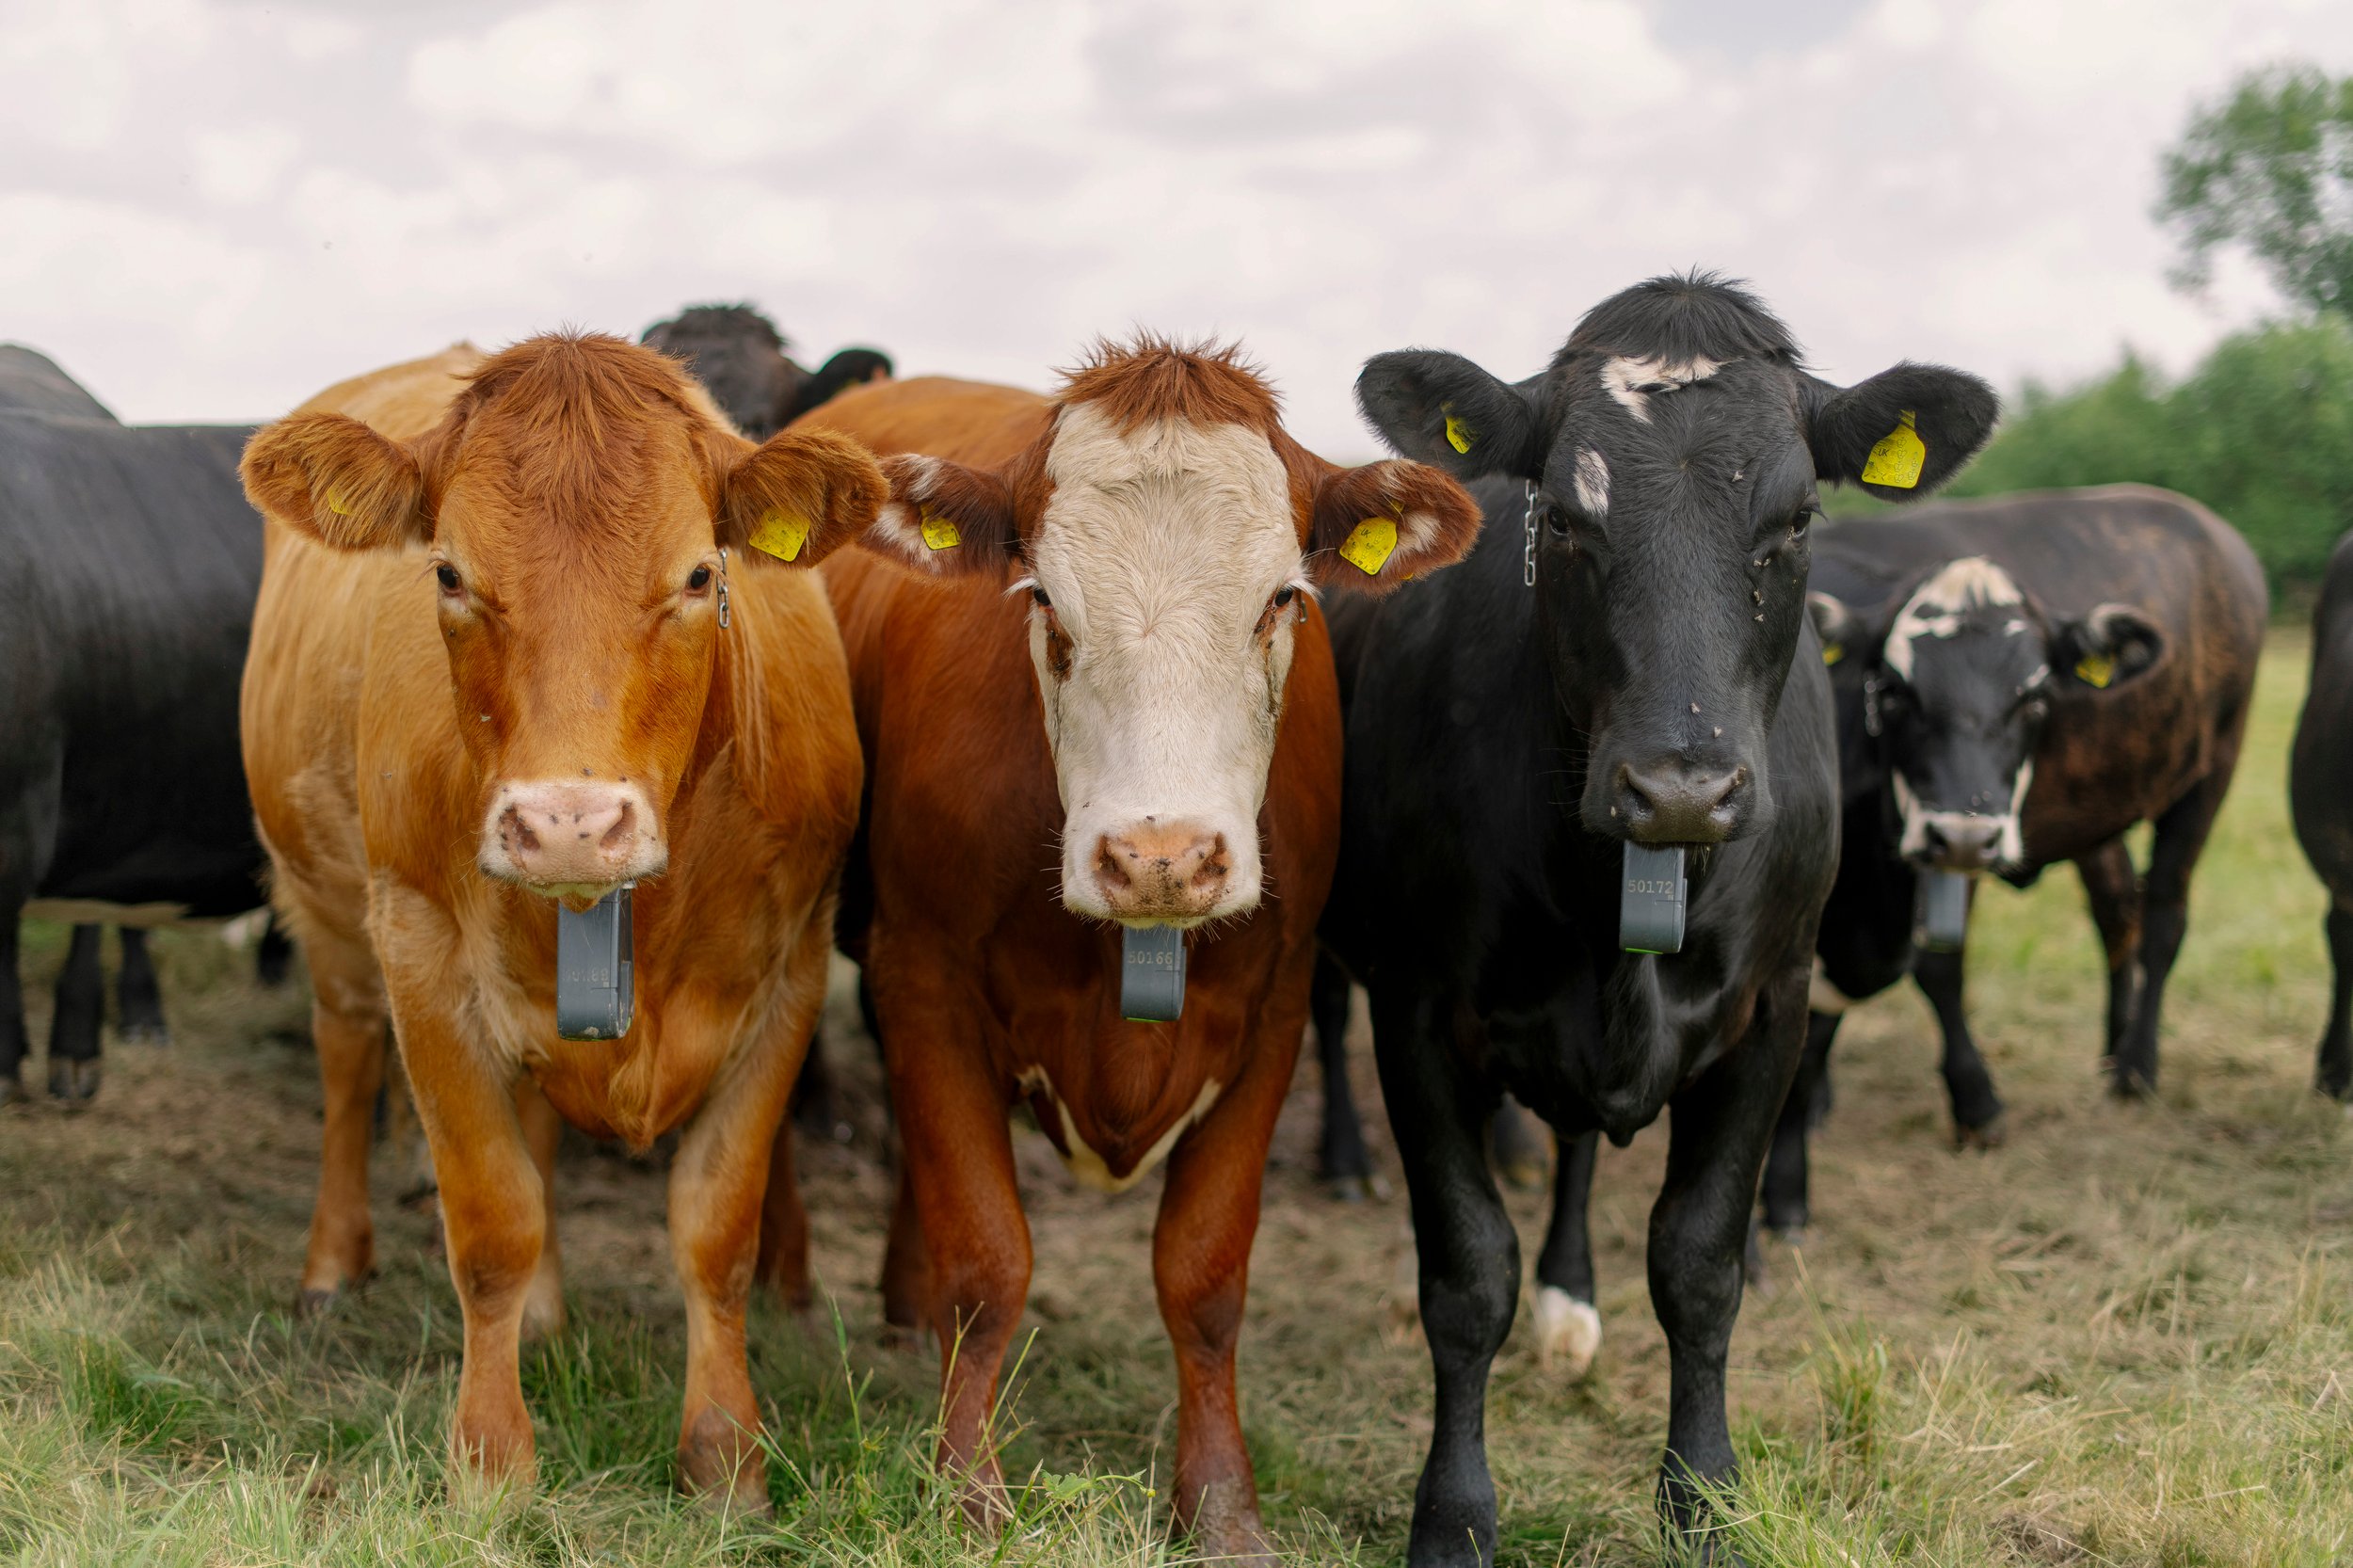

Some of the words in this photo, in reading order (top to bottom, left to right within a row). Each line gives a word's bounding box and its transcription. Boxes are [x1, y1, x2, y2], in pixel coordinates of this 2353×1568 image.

[1878, 448, 1890, 457] UK
[1360, 528, 1371, 538] UK
[1626, 879, 1673, 894] 50172
